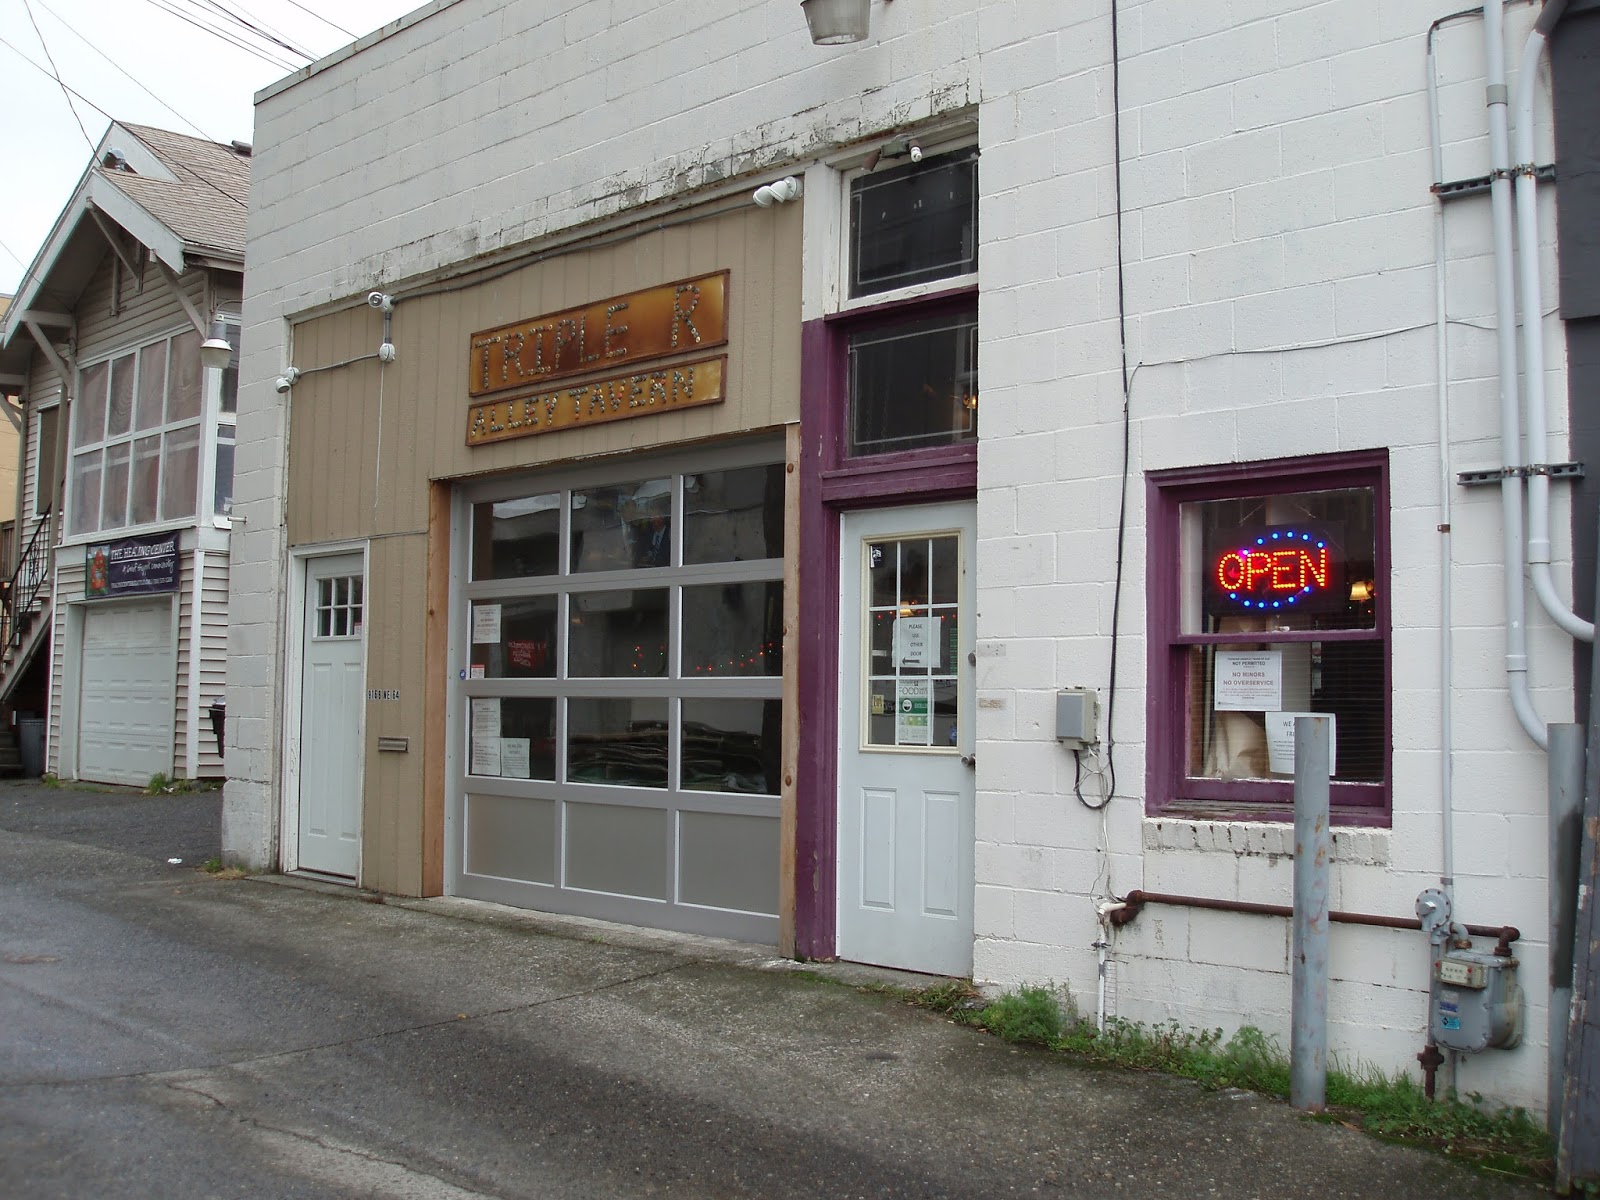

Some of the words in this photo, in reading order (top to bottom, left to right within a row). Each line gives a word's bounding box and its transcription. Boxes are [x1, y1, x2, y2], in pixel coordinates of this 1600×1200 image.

[474, 302, 629, 389] TRIPLE
[670, 284, 701, 348] R
[470, 392, 559, 437] ALLEY
[568, 366, 695, 420] TAVERN
[111, 548, 123, 560] THE
[123, 545, 151, 559] HEALING
[151, 541, 175, 555] CENTER
[1218, 547, 1328, 590] OPEN
